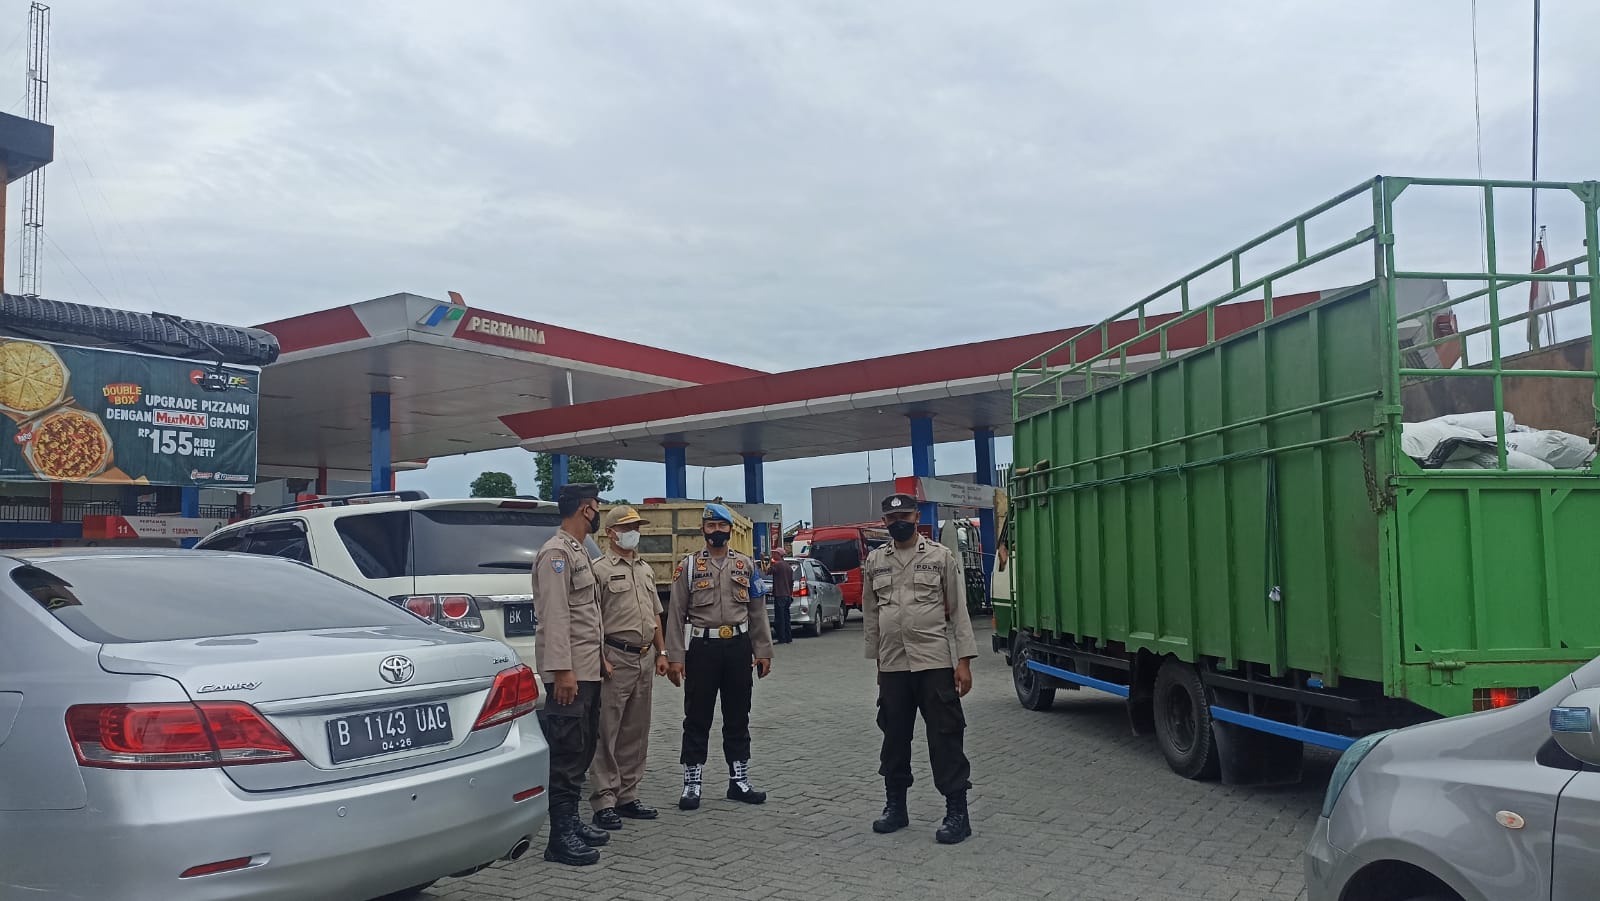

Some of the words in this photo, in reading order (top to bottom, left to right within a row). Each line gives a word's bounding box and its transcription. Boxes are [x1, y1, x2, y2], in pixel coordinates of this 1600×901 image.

[470, 316, 546, 345] PERTAMINA
[102, 386, 142, 397] DOUBLE
[114, 395, 135, 405] BOX
[145, 394, 198, 411] UPGRADE
[201, 400, 250, 416] PIZZAMU
[106, 408, 152, 423] DENGAN
[209, 417, 249, 431] GRATIS!
[149, 429, 193, 457] 155
[193, 438, 216, 448] RIBU
[193, 448, 216, 458] NETT
[117, 525, 128, 534] 11
[509, 610, 522, 624] BK
[338, 720, 351, 746] B
[364, 711, 407, 741] 1143
[415, 706, 447, 732] UAC
